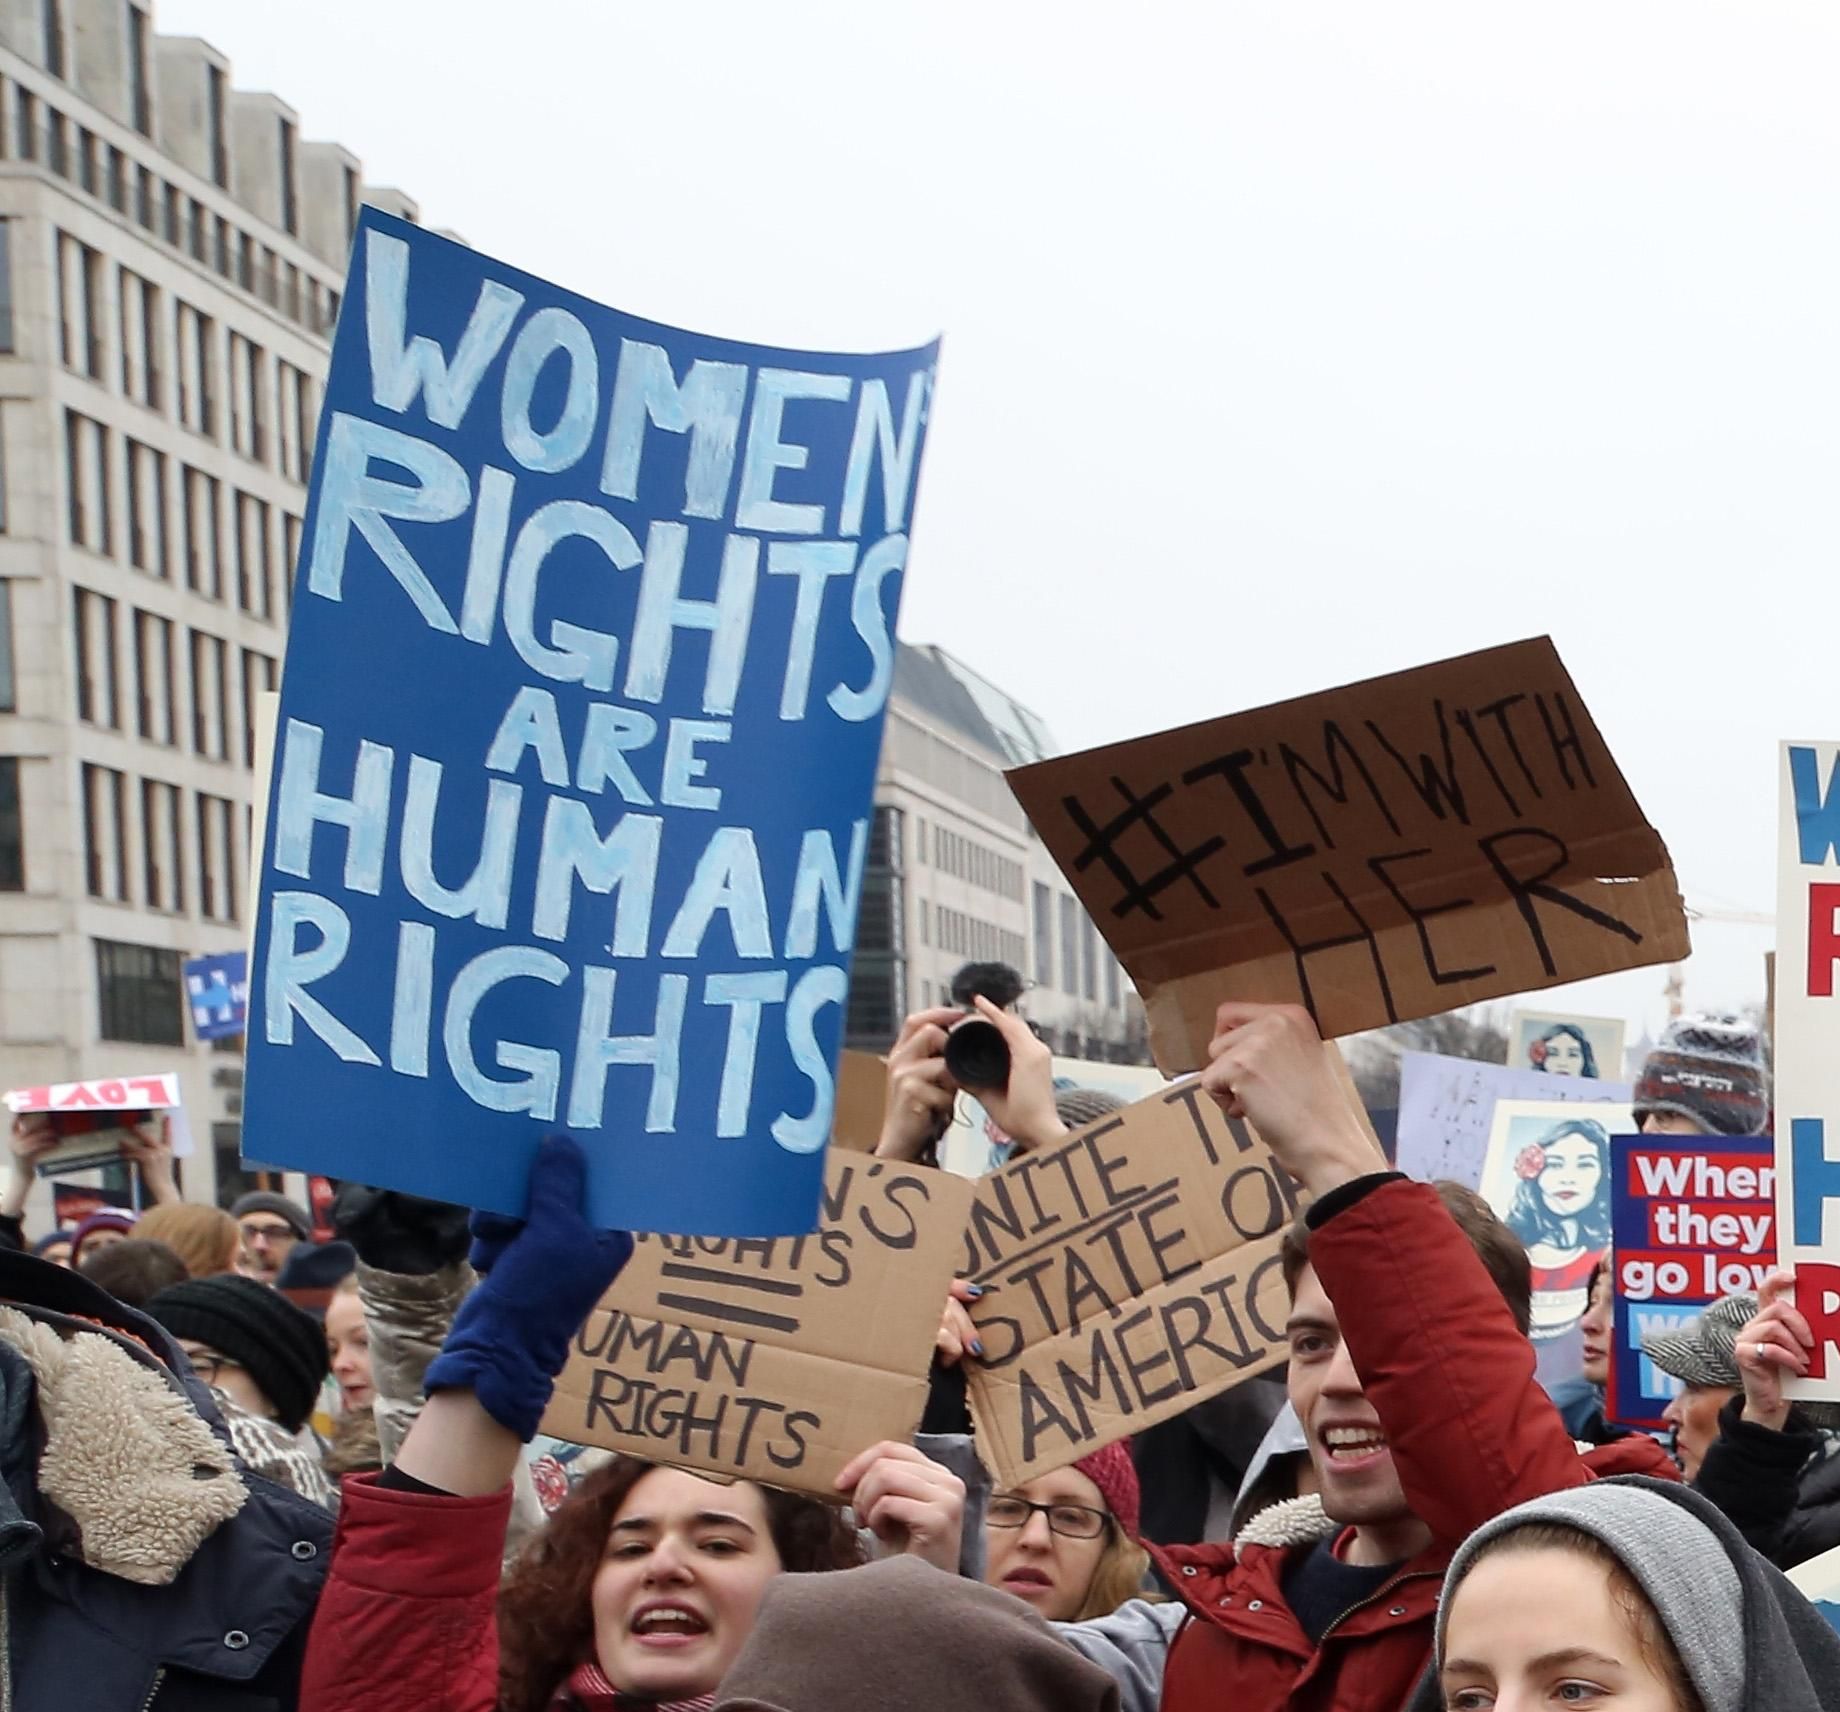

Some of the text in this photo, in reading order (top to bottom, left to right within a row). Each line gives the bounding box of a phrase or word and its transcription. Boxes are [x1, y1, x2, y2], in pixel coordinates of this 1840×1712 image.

[309, 412, 907, 722] RIGHTS
[486, 687, 732, 810] ARE
[274, 718, 866, 960] HUMAN
[1255, 826, 1642, 1022] HER
[266, 893, 848, 1153] RIGHTS
[1622, 1260, 1689, 1300] go
[1654, 1204, 1772, 1253] they
[575, 1310, 754, 1387] UMAN
[586, 1368, 821, 1469] RIGHTS
[1020, 1255, 1288, 1462] AMERIC
